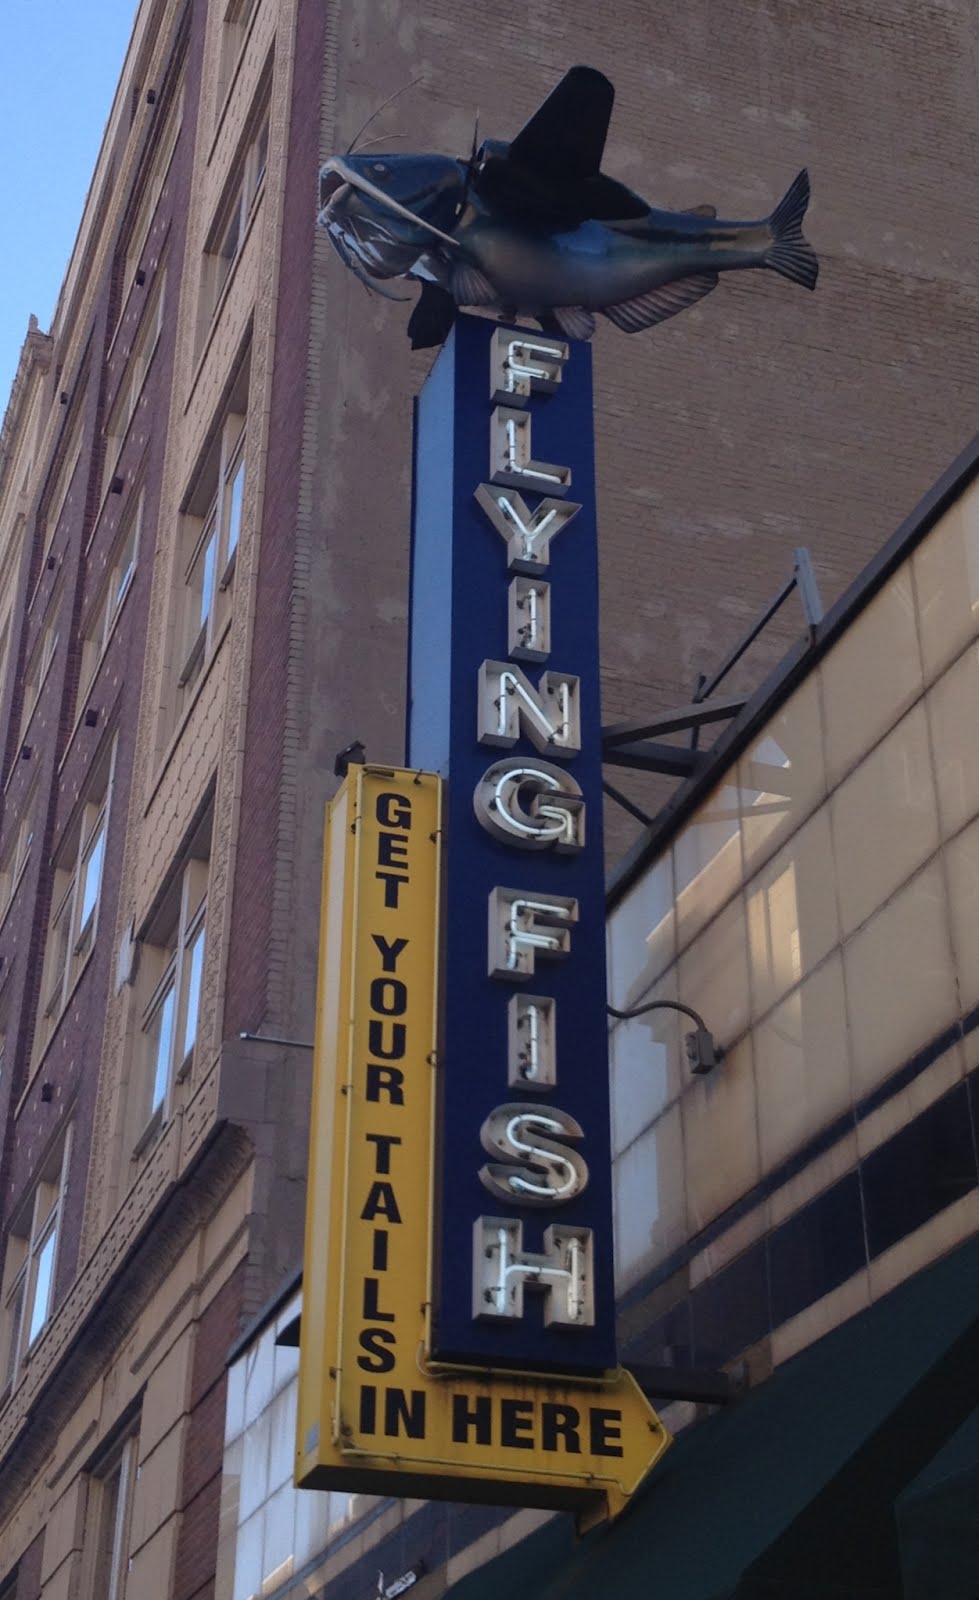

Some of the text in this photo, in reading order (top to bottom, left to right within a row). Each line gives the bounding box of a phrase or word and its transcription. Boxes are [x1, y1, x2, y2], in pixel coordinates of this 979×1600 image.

[357, 793, 412, 1373] GET YOUR TAILS
[472, 327, 594, 1328] FLYING FISH
[359, 1385, 624, 1458] IN HERE
